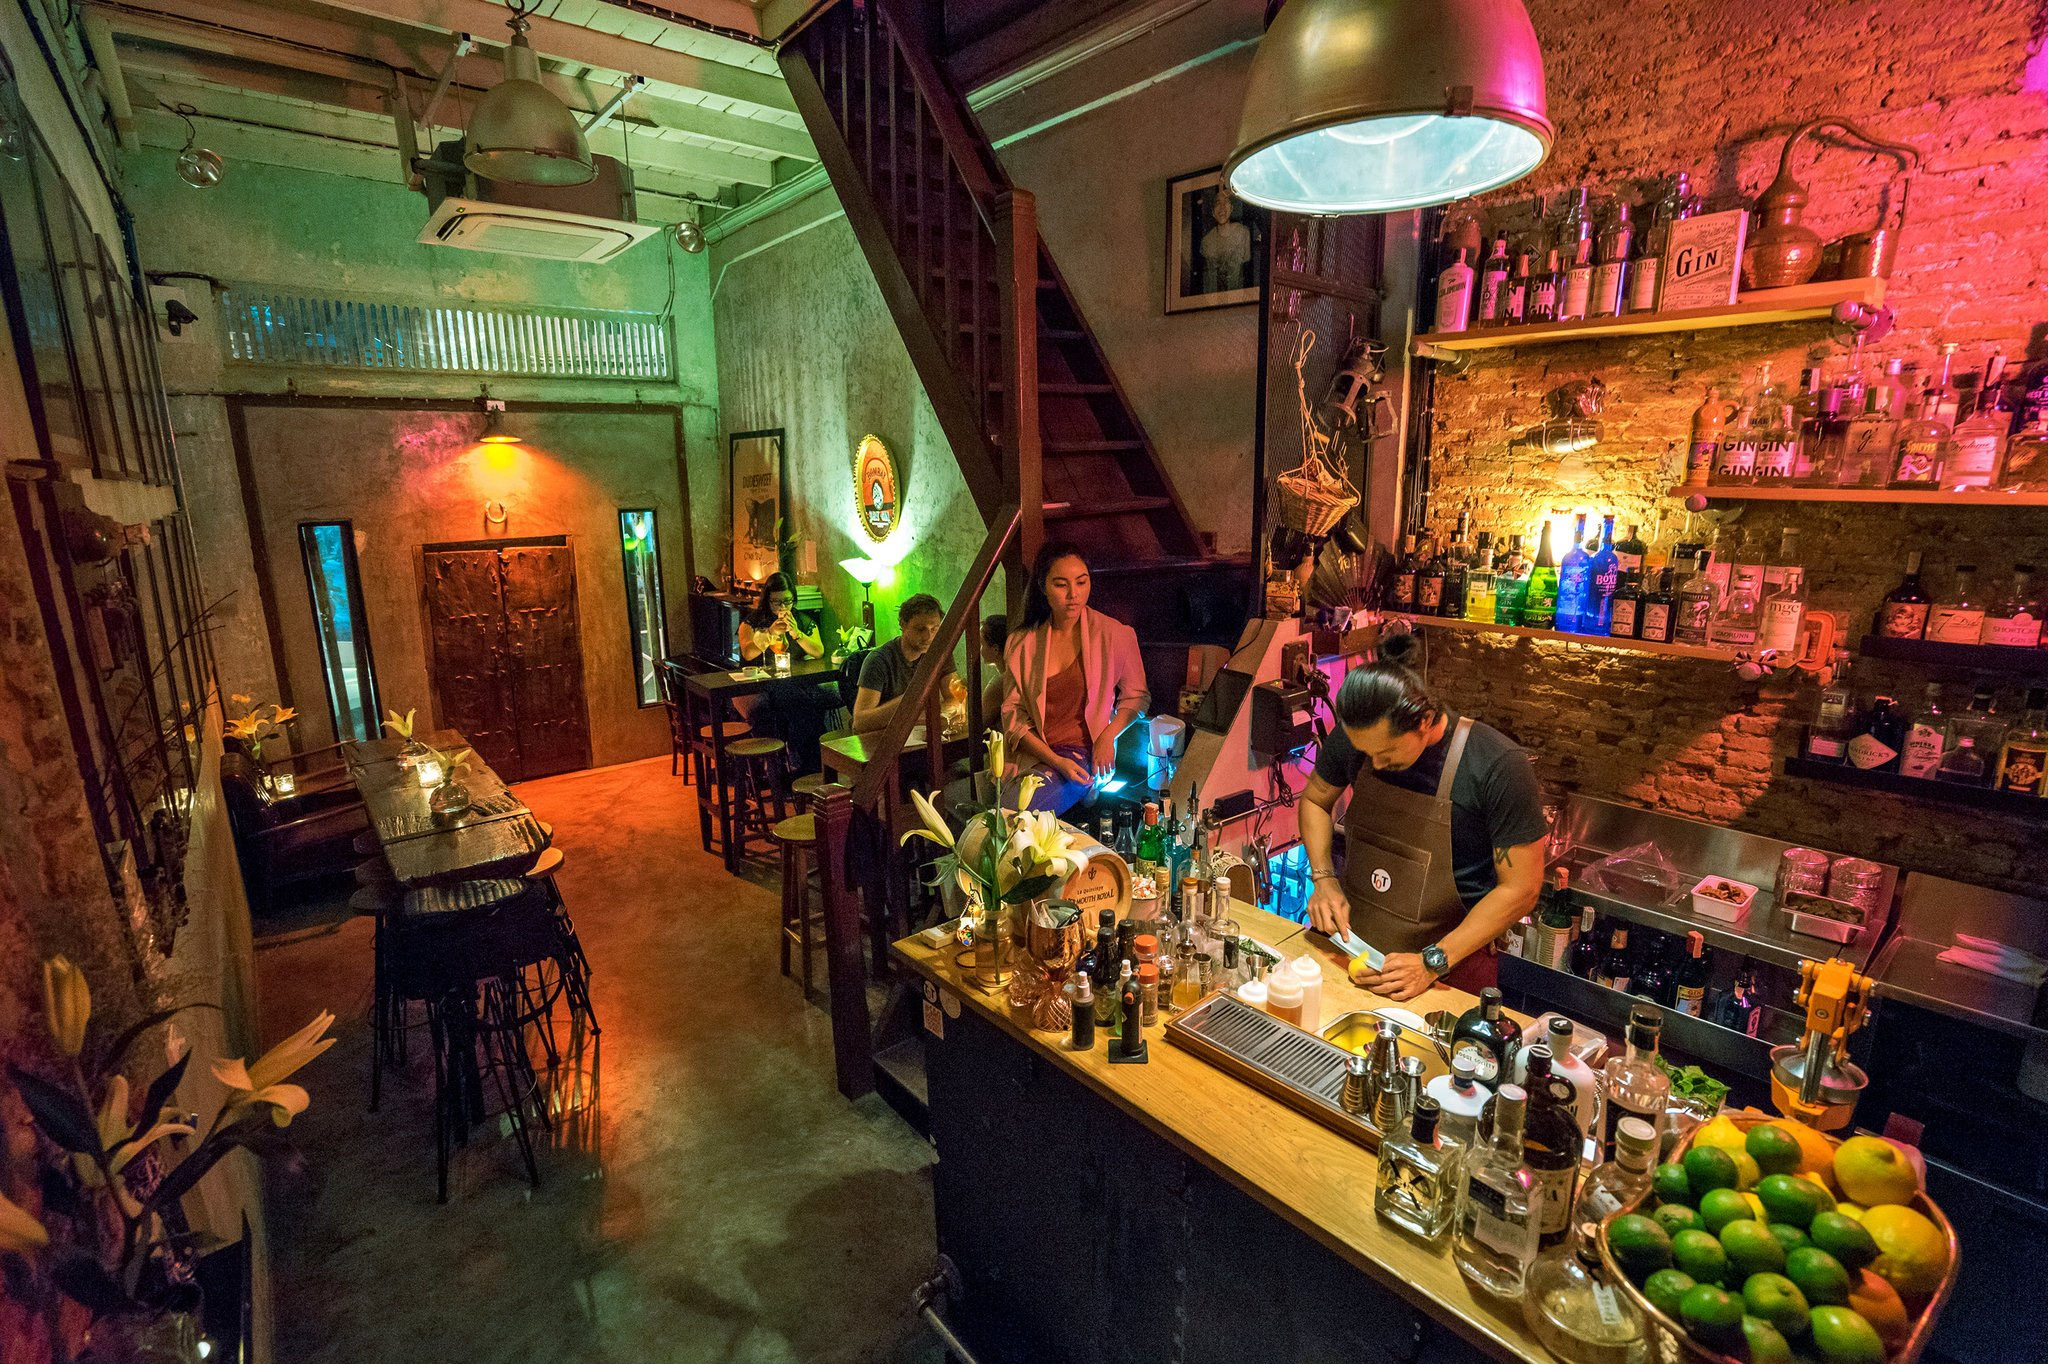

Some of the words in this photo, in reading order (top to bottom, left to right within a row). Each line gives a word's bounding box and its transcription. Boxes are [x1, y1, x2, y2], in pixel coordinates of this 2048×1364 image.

[1723, 441, 1755, 452] GIN
[1759, 441, 1790, 452] GIN
[1719, 465, 1752, 477] GIN
[1755, 465, 1785, 477] GIN
[1096, 888, 1115, 901] ROYAL
